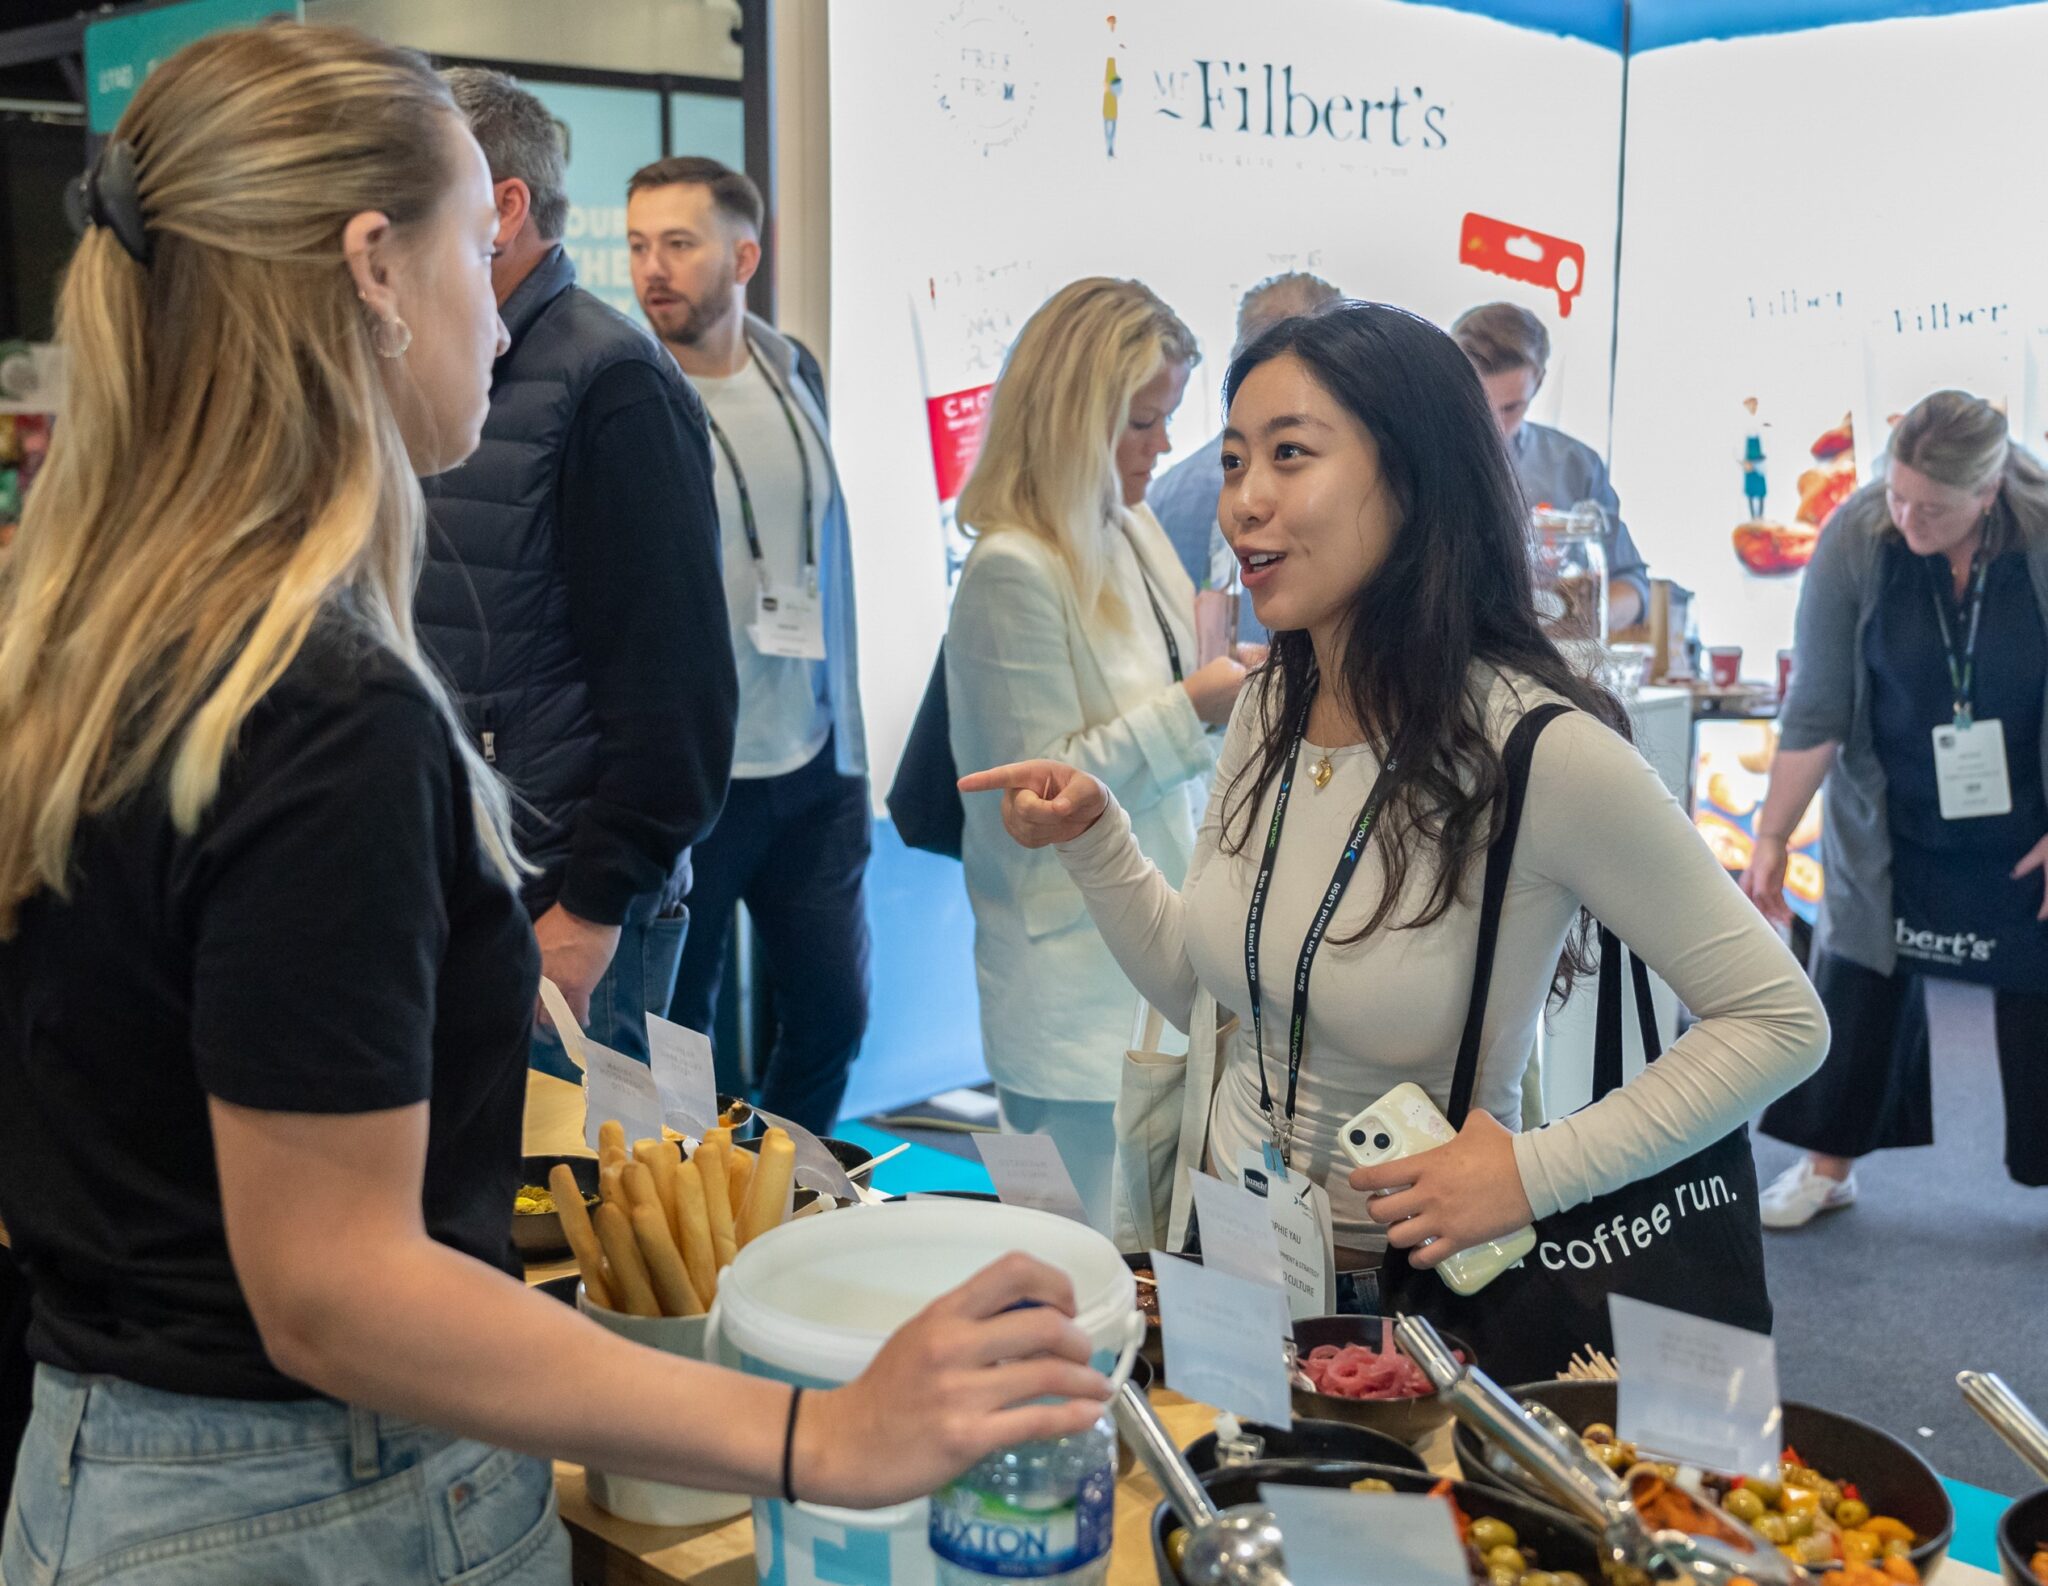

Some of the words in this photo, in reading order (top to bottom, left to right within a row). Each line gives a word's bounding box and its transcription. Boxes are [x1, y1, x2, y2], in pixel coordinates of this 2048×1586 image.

[1193, 59, 1447, 149] Filbert's
[1269, 793, 1287, 848] ProAmpac
[1258, 870, 1269, 889] See
[1254, 891, 1262, 904] us
[1324, 882, 1341, 908] L950
[1251, 906, 1258, 920] on
[1312, 908, 1329, 939] stand
[1248, 922, 1256, 953] stand
[1306, 940, 1315, 954] on
[1301, 956, 1310, 970] us
[1297, 972, 1306, 992] See
[1290, 1014, 1302, 1071] ProAmpac
[1539, 1202, 1672, 1270] coffee
[1674, 1174, 1737, 1218] run.
[1287, 1274, 1315, 1298] CULTURE
